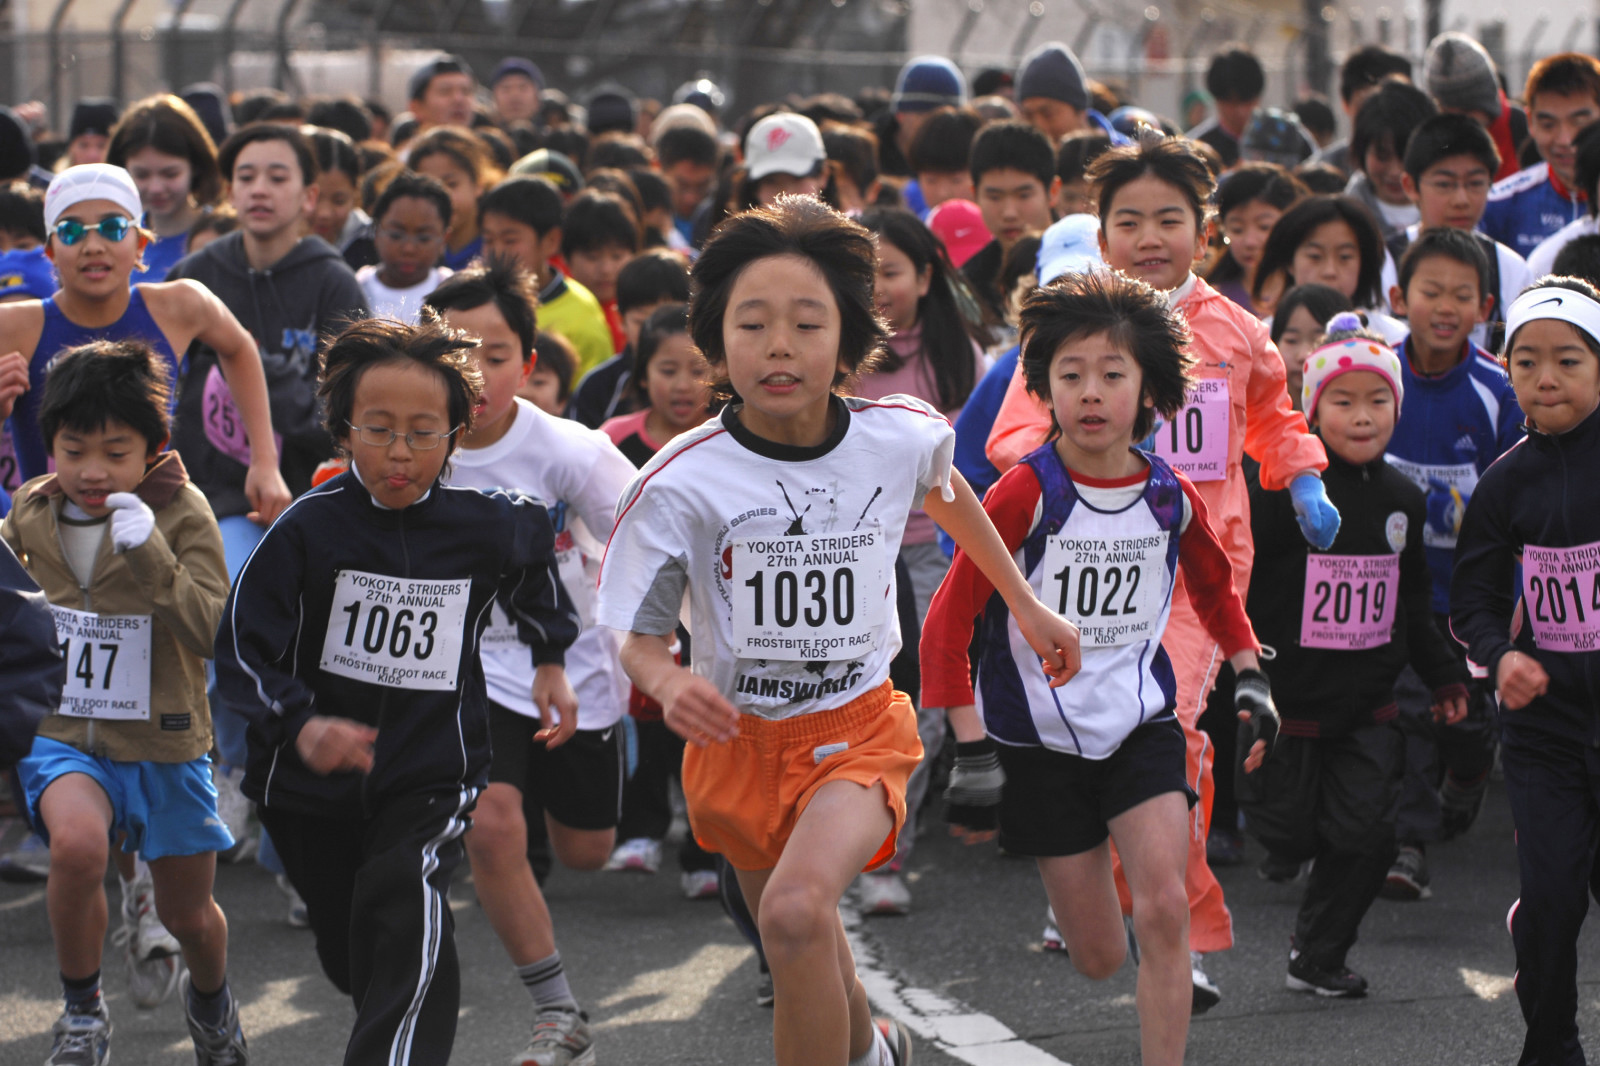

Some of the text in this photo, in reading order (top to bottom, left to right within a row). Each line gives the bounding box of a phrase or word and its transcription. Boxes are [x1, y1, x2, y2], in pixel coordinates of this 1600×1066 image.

[1171, 407, 1203, 454] 10
[730, 507, 777, 528] SERIES
[747, 533, 874, 553] YOKOTA STRIDERS
[1059, 536, 1160, 551] YOKOTA STRIDERS
[767, 551, 859, 567] 27th ANNUAL
[1075, 551, 1146, 563] 27th ANNUAL
[1529, 546, 1600, 562] YOKOTA STRID
[1318, 559, 1358, 569] YOKOTA
[1539, 559, 1600, 574] 27th ANNUA
[1332, 569, 1390, 579] 27th ANNUAL
[352, 575, 461, 596] YOKOTA STRIDERS
[1054, 565, 1141, 617] 1022
[366, 589, 445, 608] 27th ANNUAL
[745, 567, 855, 628] 1030
[1312, 580, 1386, 624] 2019
[83, 617, 140, 630] STRIDERS
[343, 600, 438, 660] 1063
[1107, 625, 1129, 636] FOOT
[1131, 621, 1149, 631] RACE
[77, 627, 123, 640] ANNUAL
[747, 632, 871, 649] FROSTBITE FOOT RACE
[1094, 634, 1116, 644] KIDS
[1540, 632, 1580, 643] FROSTBITE
[1574, 640, 1595, 649] KIDS
[800, 648, 828, 658] KIDS
[60, 638, 118, 690] 147
[334, 655, 389, 674] FROSTBITE
[391, 668, 420, 680] FOOT
[421, 670, 447, 680] RACE
[377, 674, 402, 685] KIDS
[71, 704, 94, 715] KIDS
[83, 698, 108, 709] FOOT
[112, 700, 138, 710] RACE
